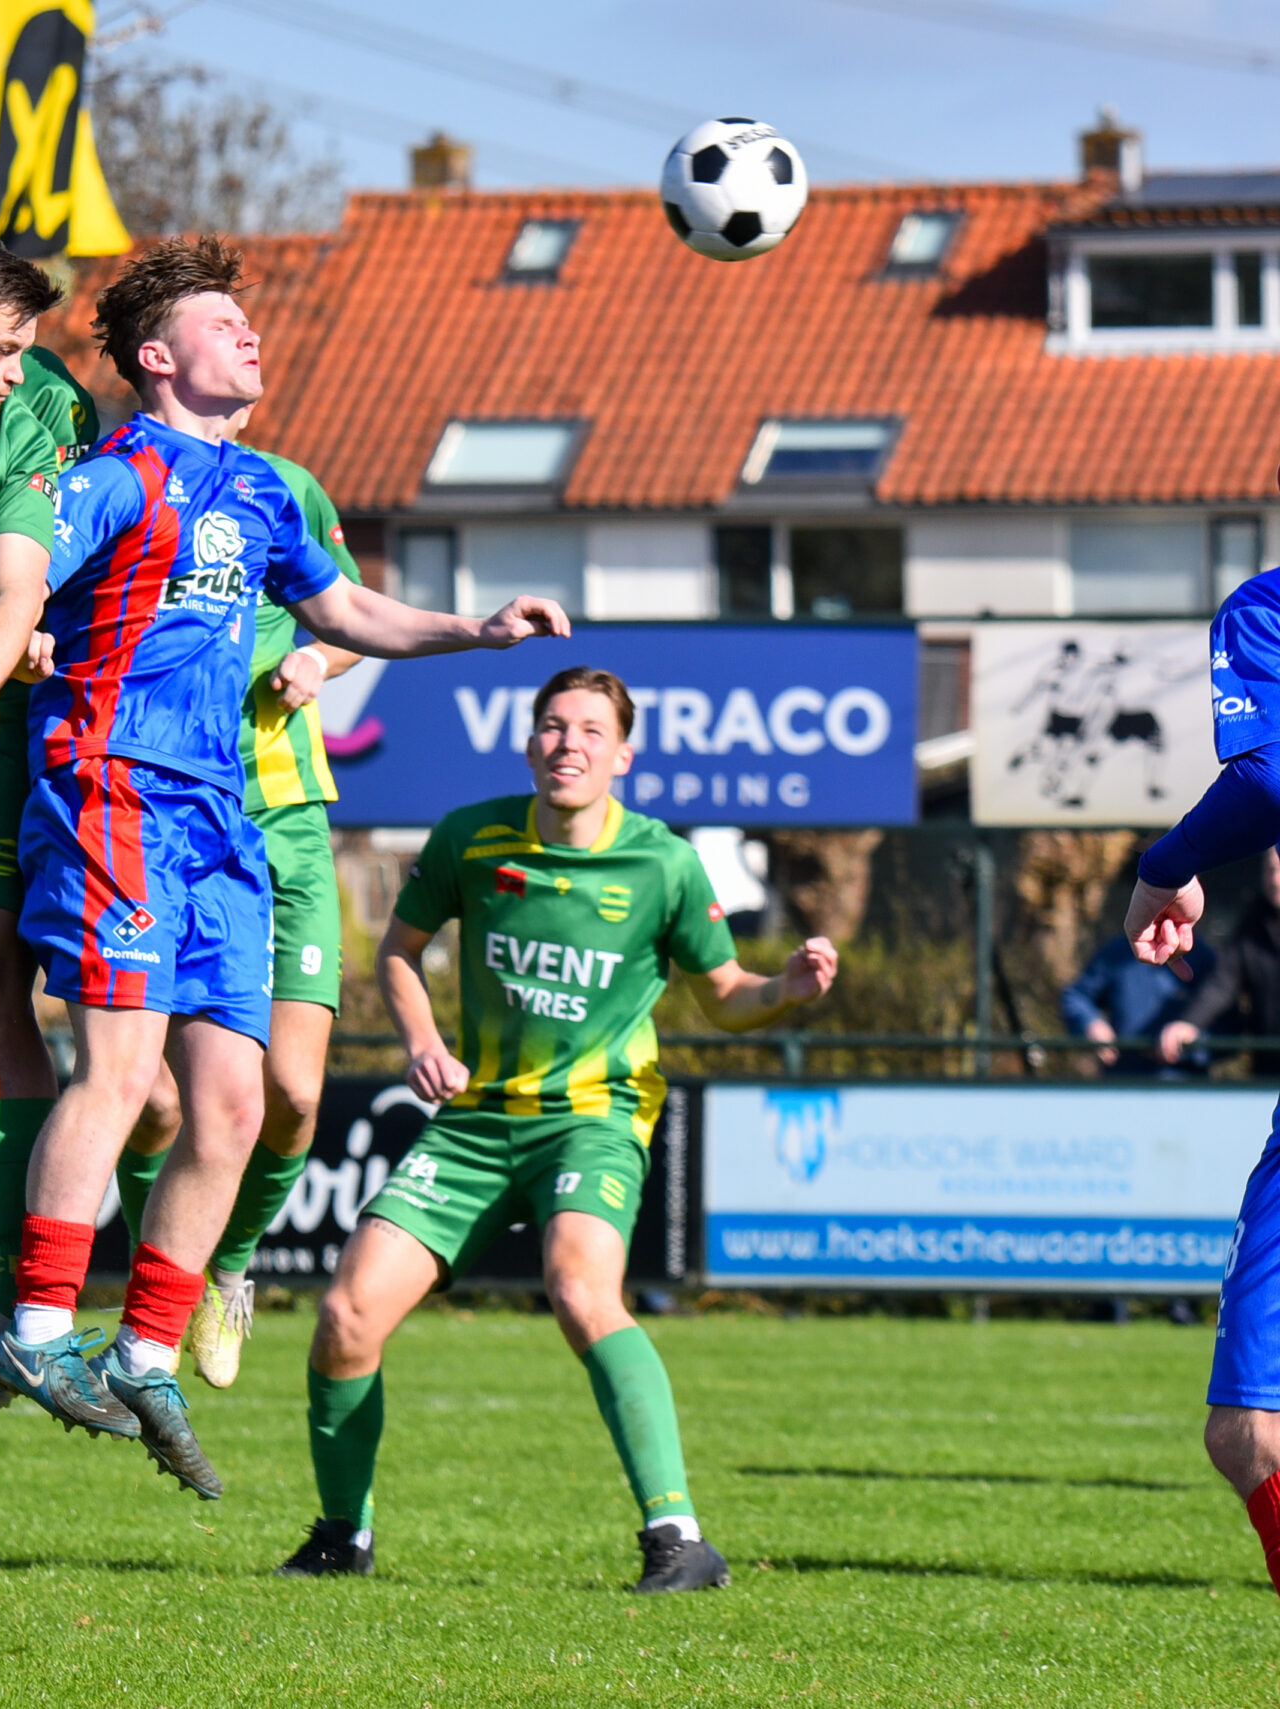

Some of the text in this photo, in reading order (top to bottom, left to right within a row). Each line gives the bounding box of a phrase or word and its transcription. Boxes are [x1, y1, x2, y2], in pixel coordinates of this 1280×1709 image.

[53, 519, 74, 544] OL
[453, 686, 892, 757] VETRACO
[610, 772, 811, 807] IPPING
[102, 947, 161, 964] Domino's
[300, 944, 322, 975] 9
[485, 931, 624, 990] EVENT
[502, 981, 589, 1023] TYRES
